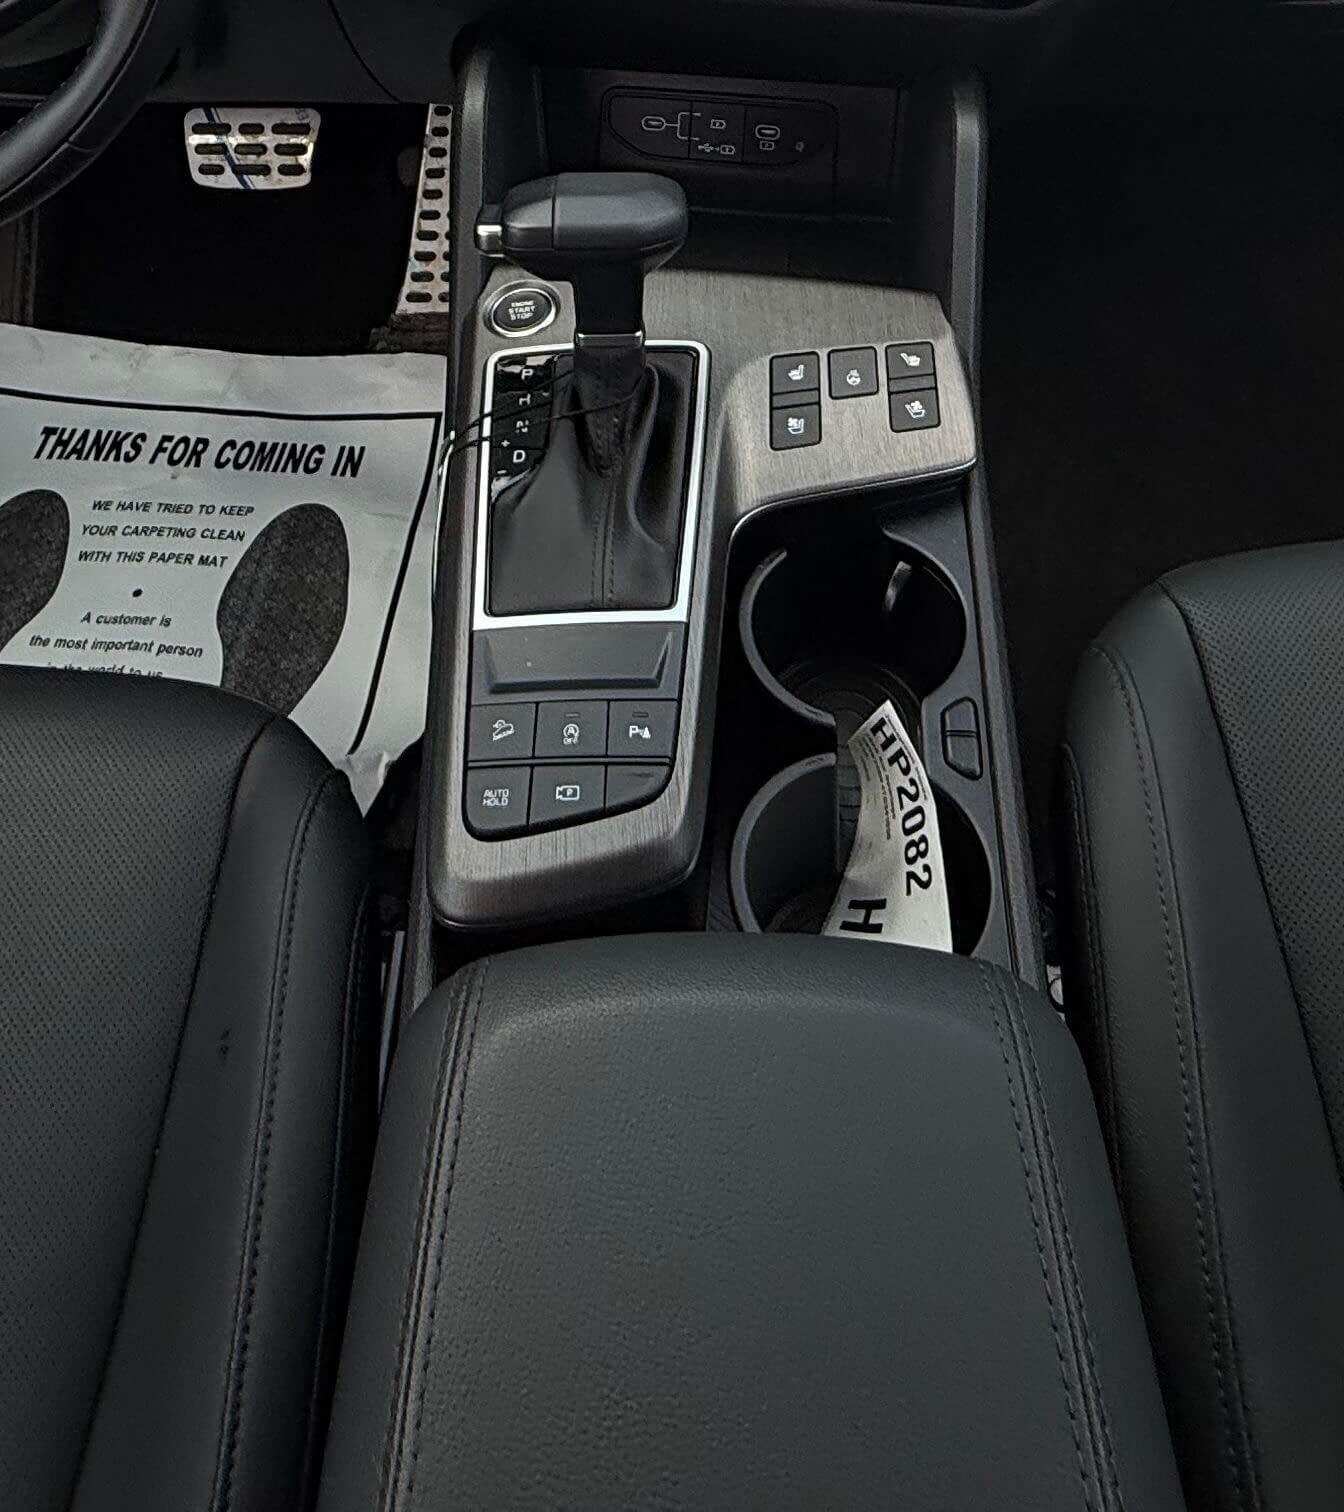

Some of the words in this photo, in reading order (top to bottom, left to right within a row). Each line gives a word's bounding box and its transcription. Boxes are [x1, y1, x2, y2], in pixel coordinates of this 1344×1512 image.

[508, 305, 536, 314] START
[510, 312, 534, 321] STOP
[521, 369, 534, 380] P
[33, 426, 148, 464] THANKS
[148, 434, 211, 468] FOR
[213, 439, 326, 475] COMING
[330, 445, 367, 478] IN
[513, 450, 526, 463] D
[92, 500, 113, 511] WE
[115, 500, 153, 513] HAVE
[157, 502, 194, 515] TRIED
[198, 504, 215, 515] TO
[219, 505, 255, 517] KEEP
[81, 524, 118, 537] YOUR
[122, 525, 197, 539] CARPETING
[200, 528, 246, 541] CLEAN
[78, 550, 112, 562] WITH
[116, 551, 144, 563] THIS
[148, 552, 195, 565] PAPER
[198, 555, 229, 568] MAT
[80, 611, 92, 624] A
[95, 613, 156, 626] customer
[159, 614, 172, 628] is
[29, 635, 51, 647] the
[53, 637, 88, 650] most
[91, 638, 154, 652] important
[156, 642, 204, 658] person
[563, 737, 579, 745] OFF
[482, 797, 509, 806] HOLD
[483, 788, 509, 798] AUTO
[870, 717, 932, 897] HP2082
[840, 898, 887, 934] H
